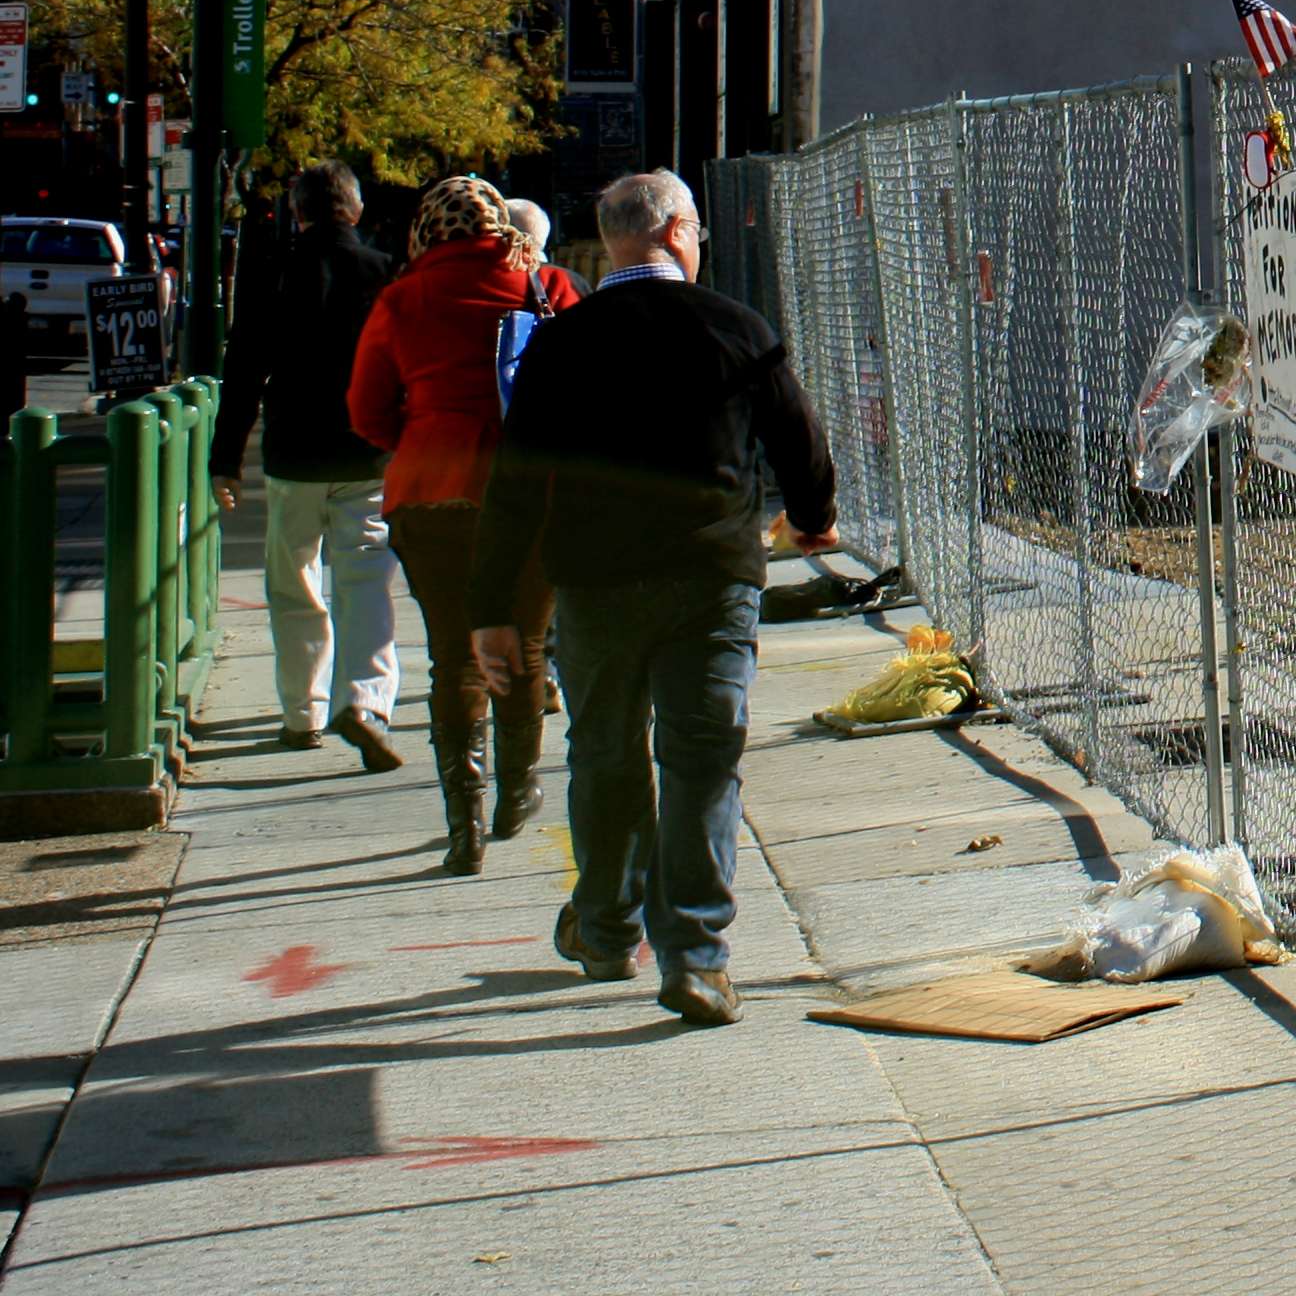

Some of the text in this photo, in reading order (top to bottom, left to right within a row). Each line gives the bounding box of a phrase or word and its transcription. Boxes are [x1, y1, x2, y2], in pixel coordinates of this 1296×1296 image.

[1262, 244, 1287, 299] FOR
[92, 282, 155, 297] EARLY BIRD
